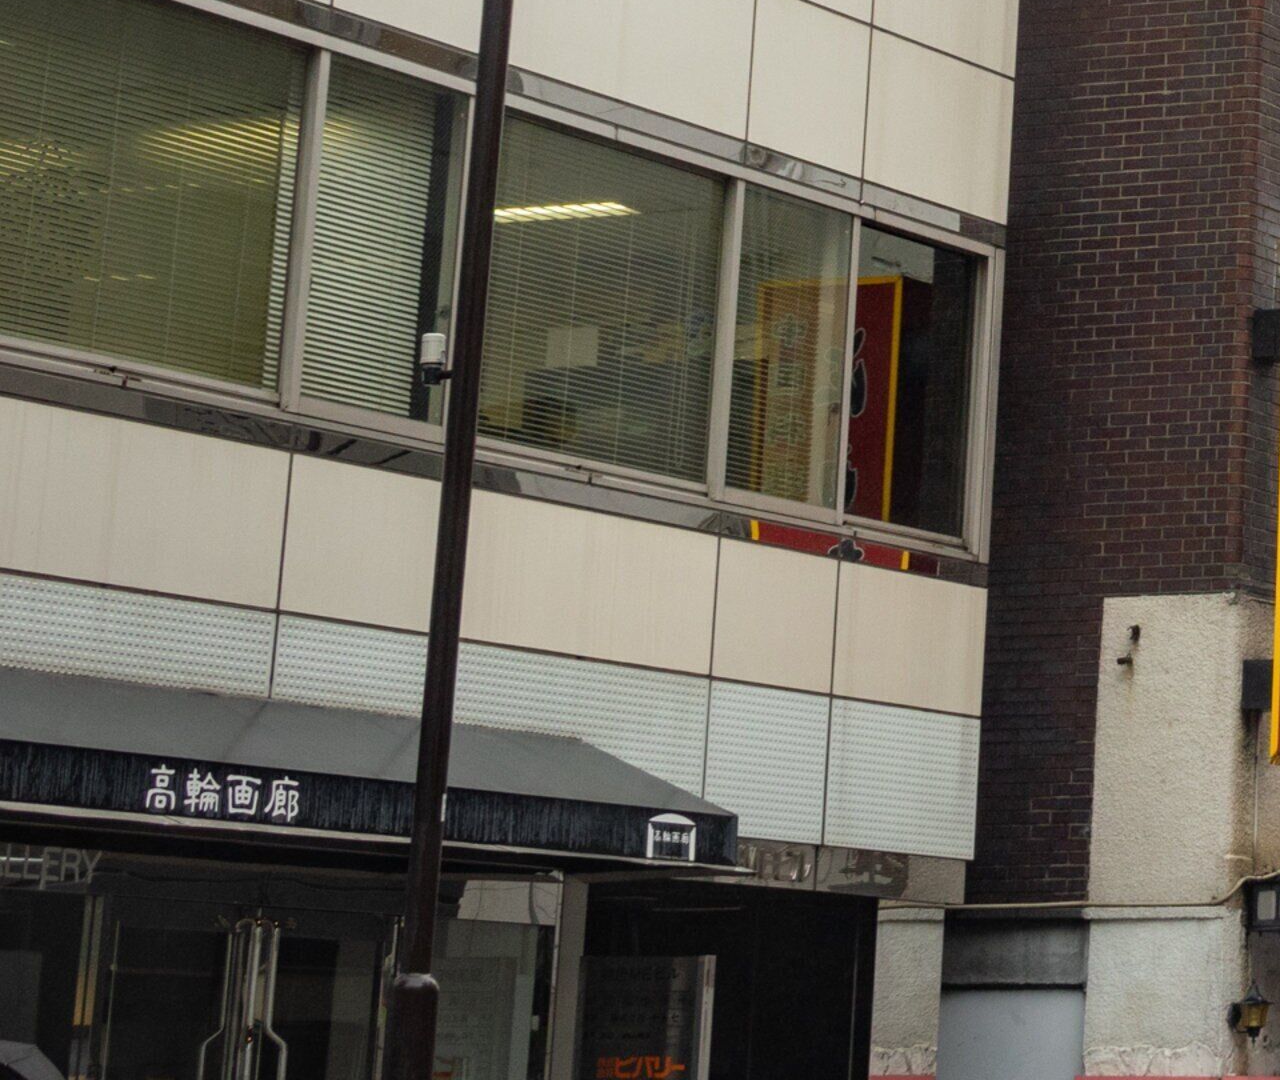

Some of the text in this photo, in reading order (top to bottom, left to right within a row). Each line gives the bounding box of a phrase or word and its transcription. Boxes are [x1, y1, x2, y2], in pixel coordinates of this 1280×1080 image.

[144, 763, 301, 822] 高輪画廊
[0, 843, 104, 884] LLERY
